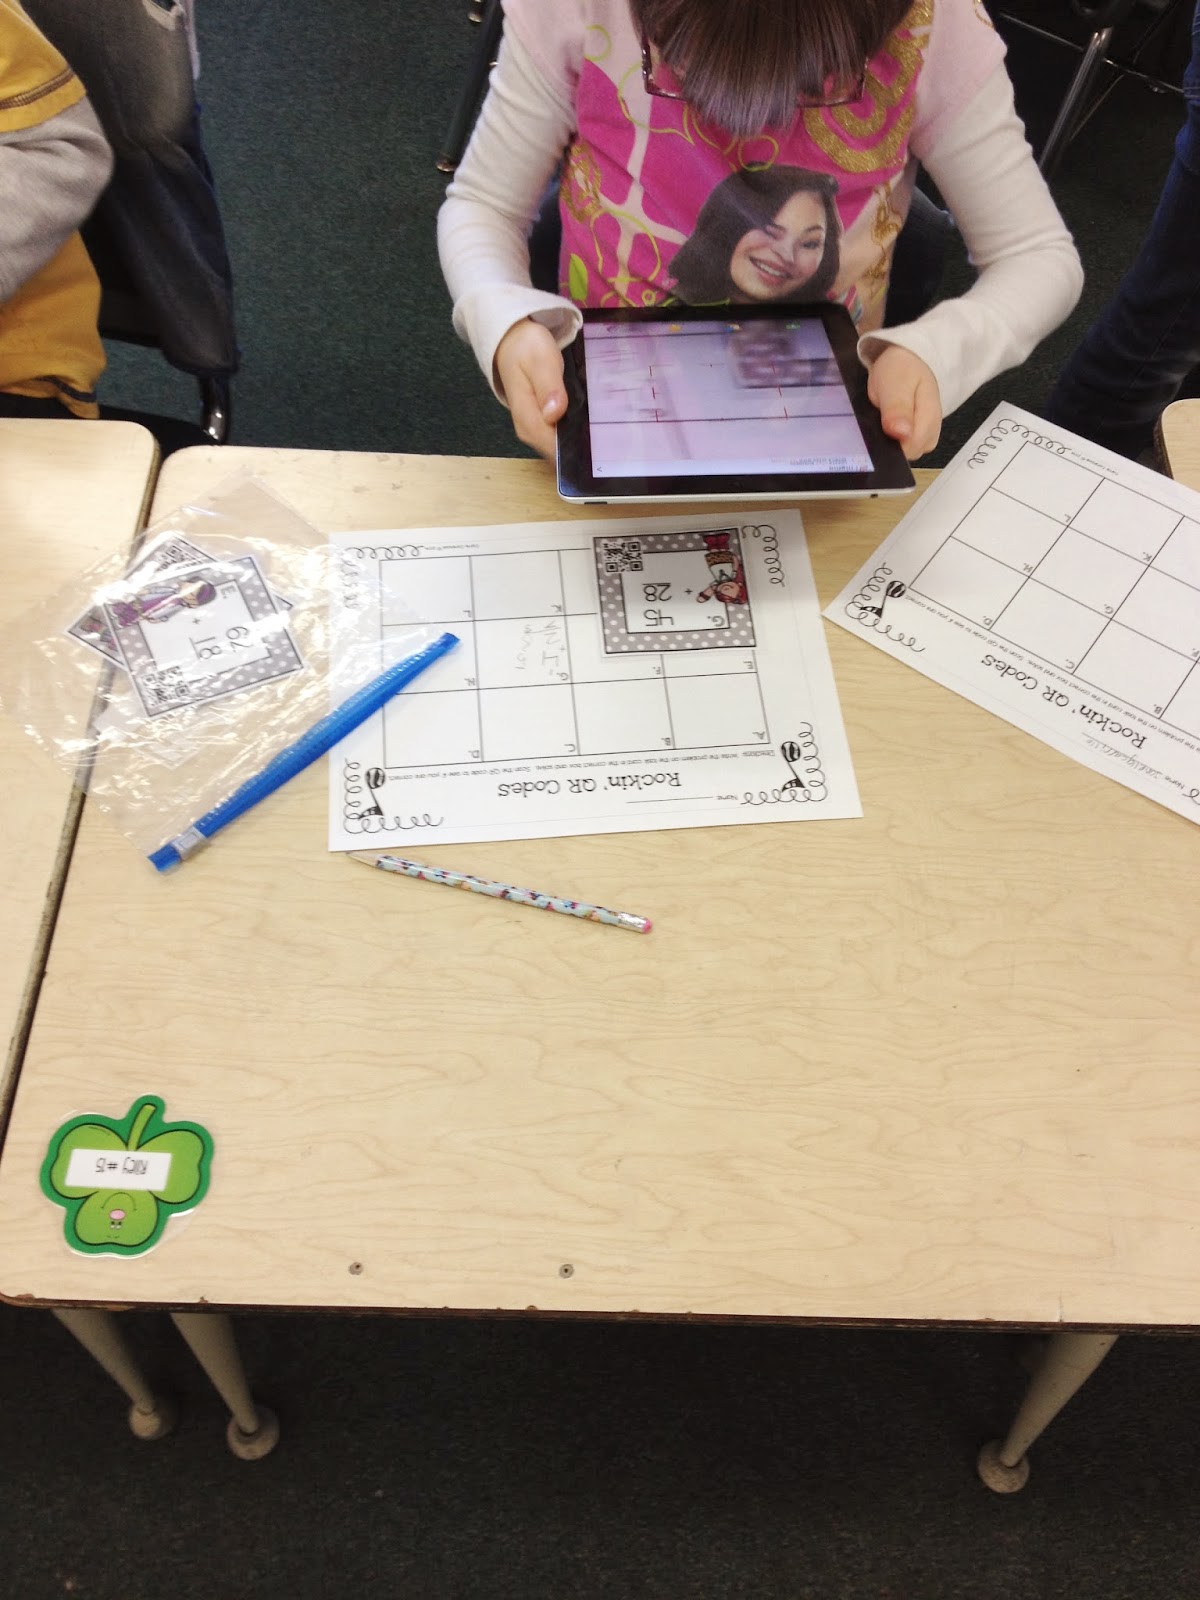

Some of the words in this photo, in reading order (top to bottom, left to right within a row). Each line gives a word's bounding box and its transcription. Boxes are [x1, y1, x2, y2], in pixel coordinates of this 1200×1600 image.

[643, 584, 672, 602] 28
[643, 609, 674, 627] 45
[1103, 604, 1114, 615] G.
[707, 615, 725, 627] G.
[983, 615, 993, 626] D.
[193, 636, 222, 660] 18
[981, 654, 1038, 691] Codes
[1065, 659, 1075, 670] C.
[1042, 685, 1070, 708] QR
[1071, 704, 1147, 750] Rockin'
[498, 779, 560, 799] Codes
[567, 778, 597, 794] QR
[603, 772, 682, 791] Rockin'
